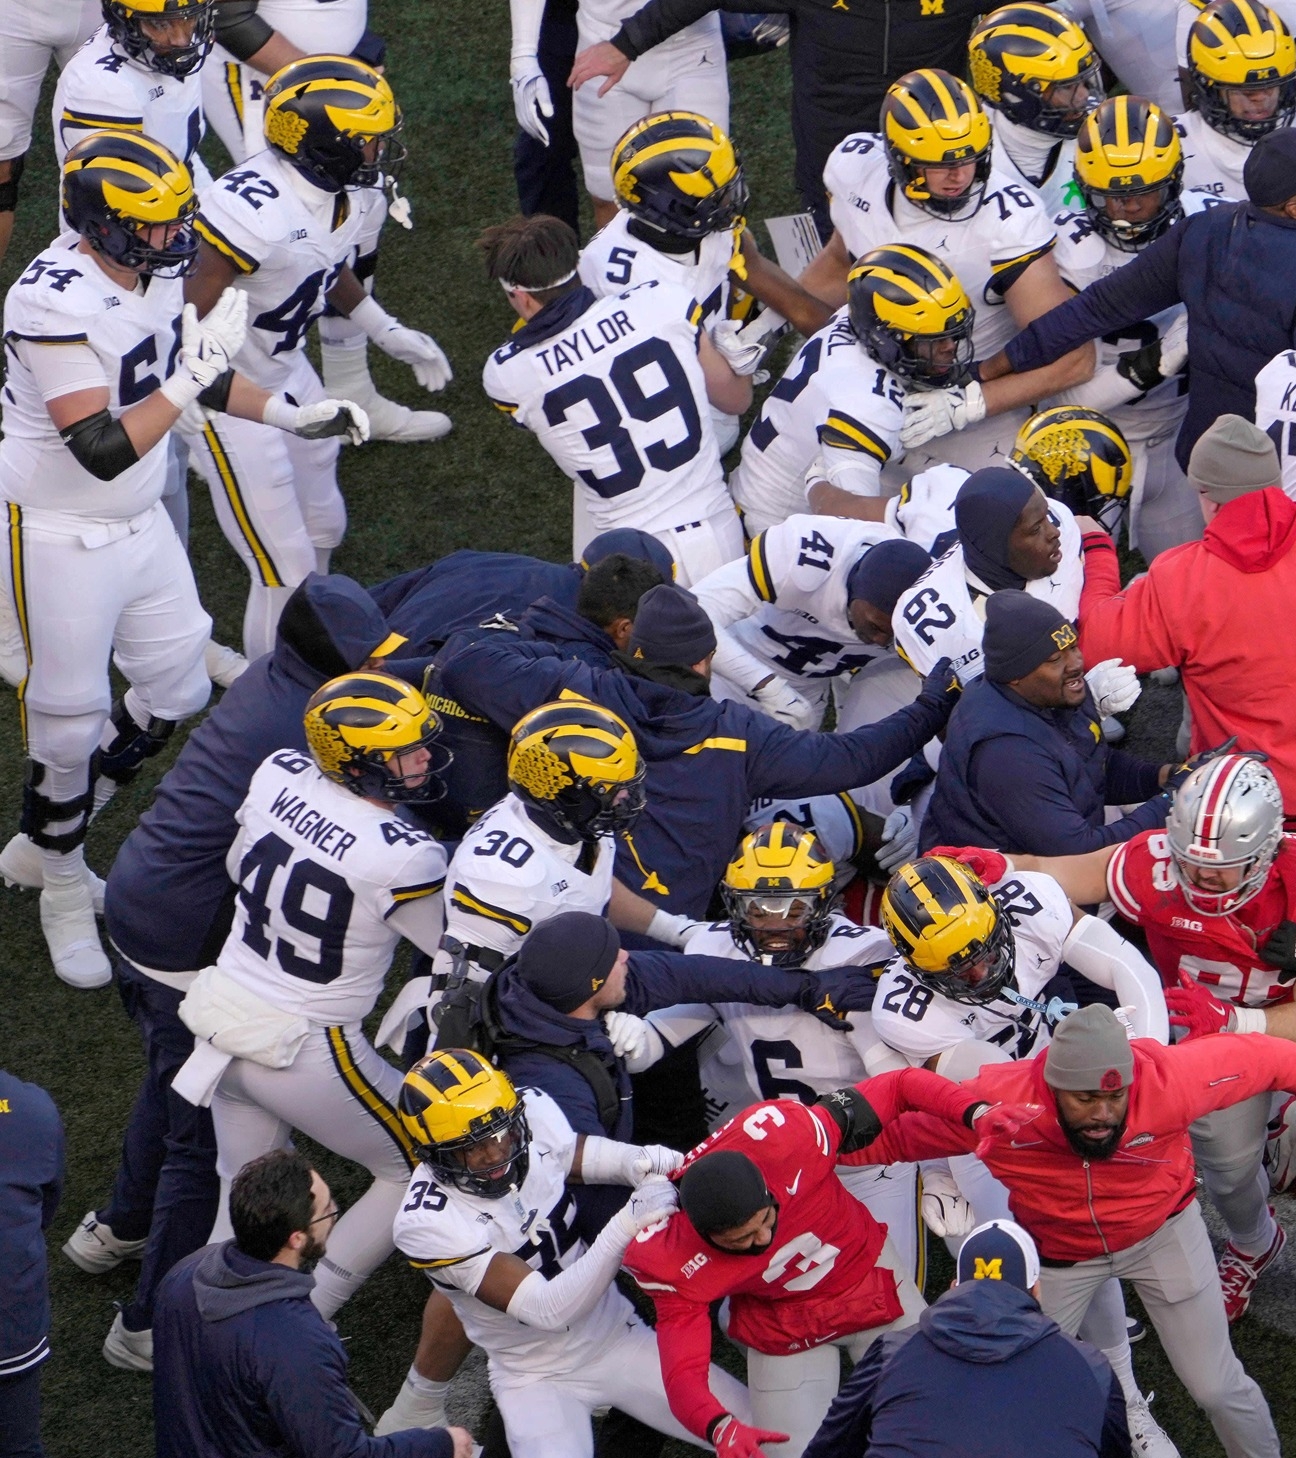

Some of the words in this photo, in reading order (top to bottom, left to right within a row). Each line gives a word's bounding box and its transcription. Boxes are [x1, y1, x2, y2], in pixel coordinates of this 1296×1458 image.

[95, 52, 130, 75] 4
[220, 169, 280, 210] 42
[982, 183, 1035, 222] 76
[19, 258, 84, 293] 54
[606, 247, 638, 286] 5
[536, 310, 636, 377] TAYLOR
[542, 336, 704, 494] 39
[796, 529, 836, 573] 41
[1050, 624, 1077, 651] M
[425, 692, 491, 724] MICHIG
[268, 786, 358, 863] WAGNER
[473, 828, 536, 870] 30
[238, 830, 356, 982] 49
[881, 973, 936, 1023] 28
[742, 1104, 787, 1142] 3
[404, 1180, 449, 1214] 35
[761, 1231, 842, 1293] 3
[974, 1257, 1003, 1281] M
